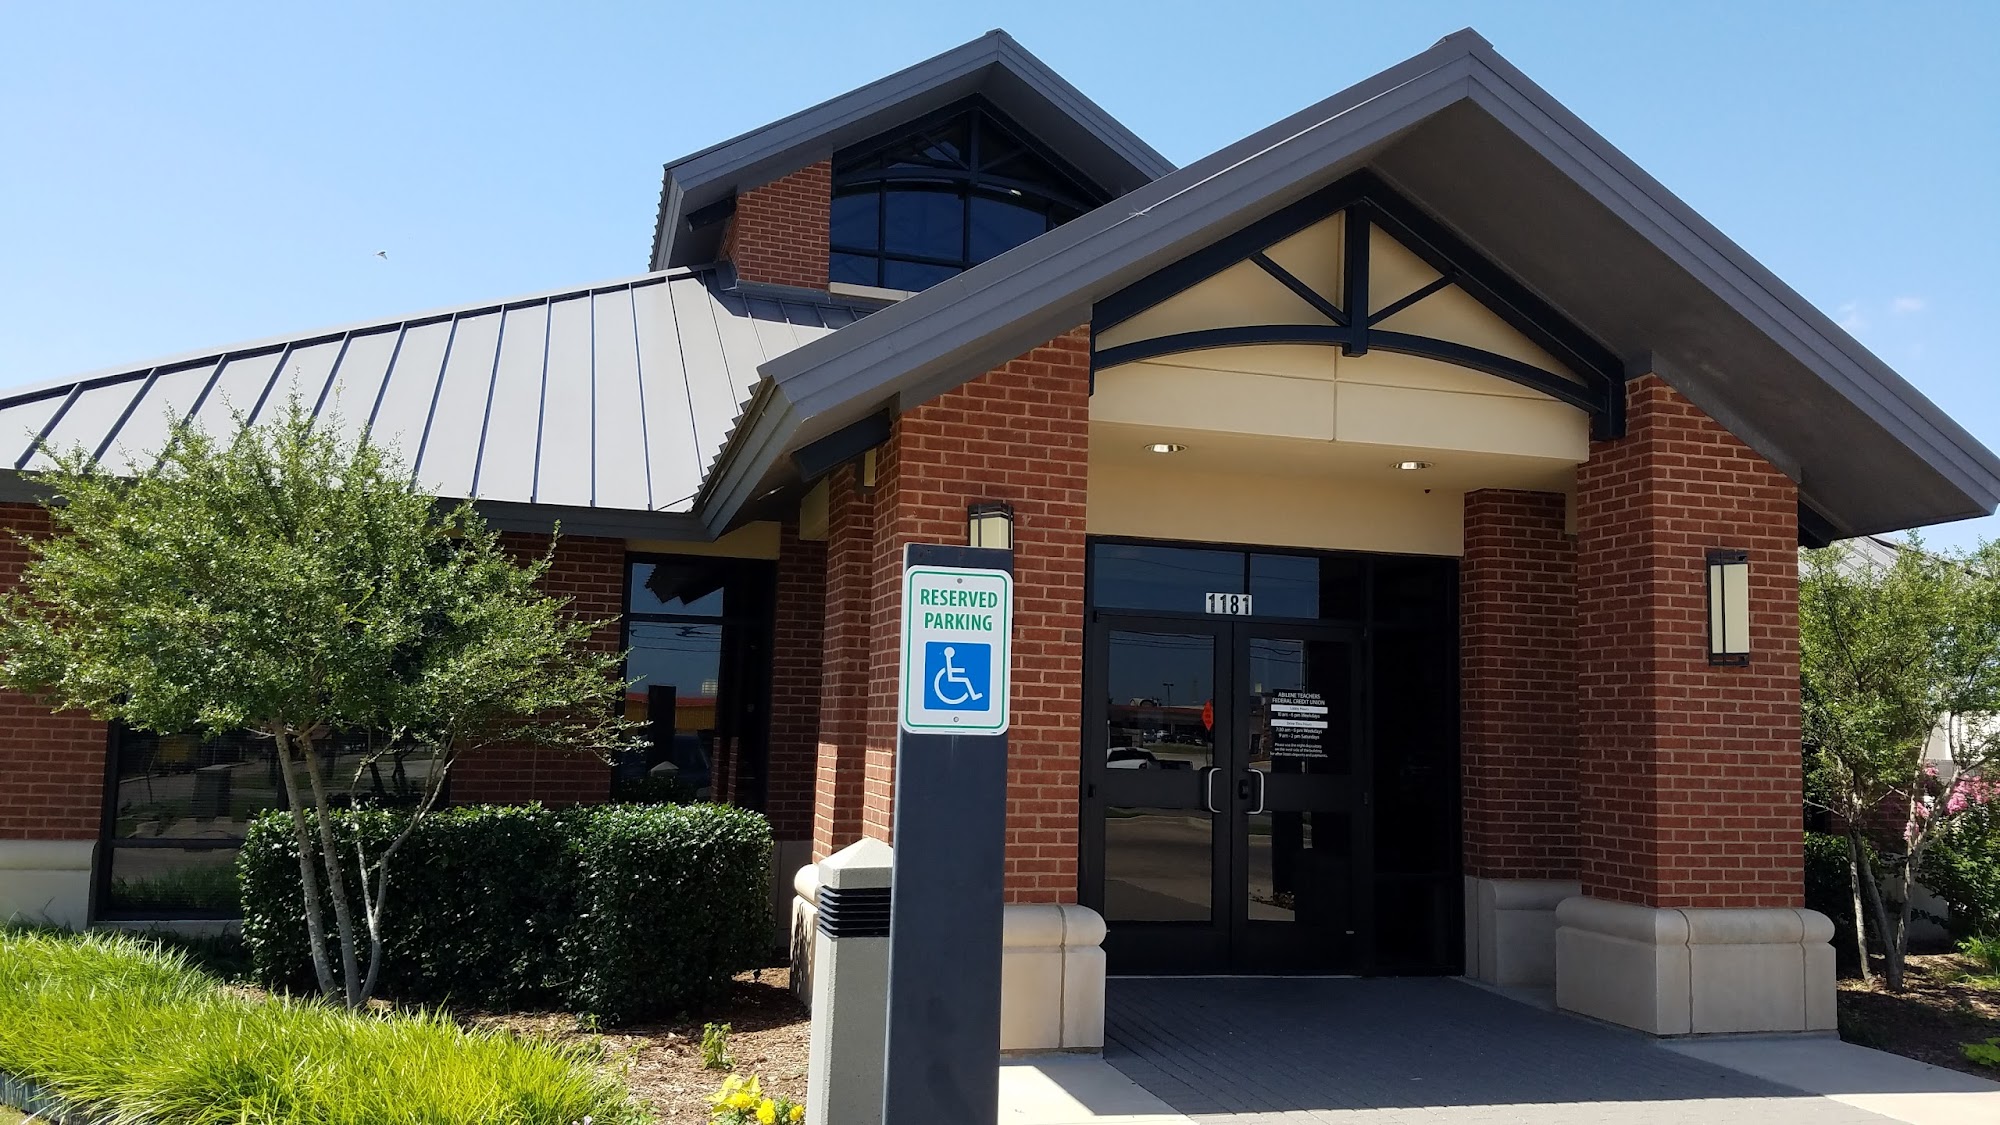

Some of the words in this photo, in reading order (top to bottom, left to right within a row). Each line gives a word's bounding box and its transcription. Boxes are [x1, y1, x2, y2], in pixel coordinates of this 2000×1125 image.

[920, 588, 998, 608] RESERVED
[1208, 593, 1250, 615] 1181
[924, 612, 993, 631] PARKING
